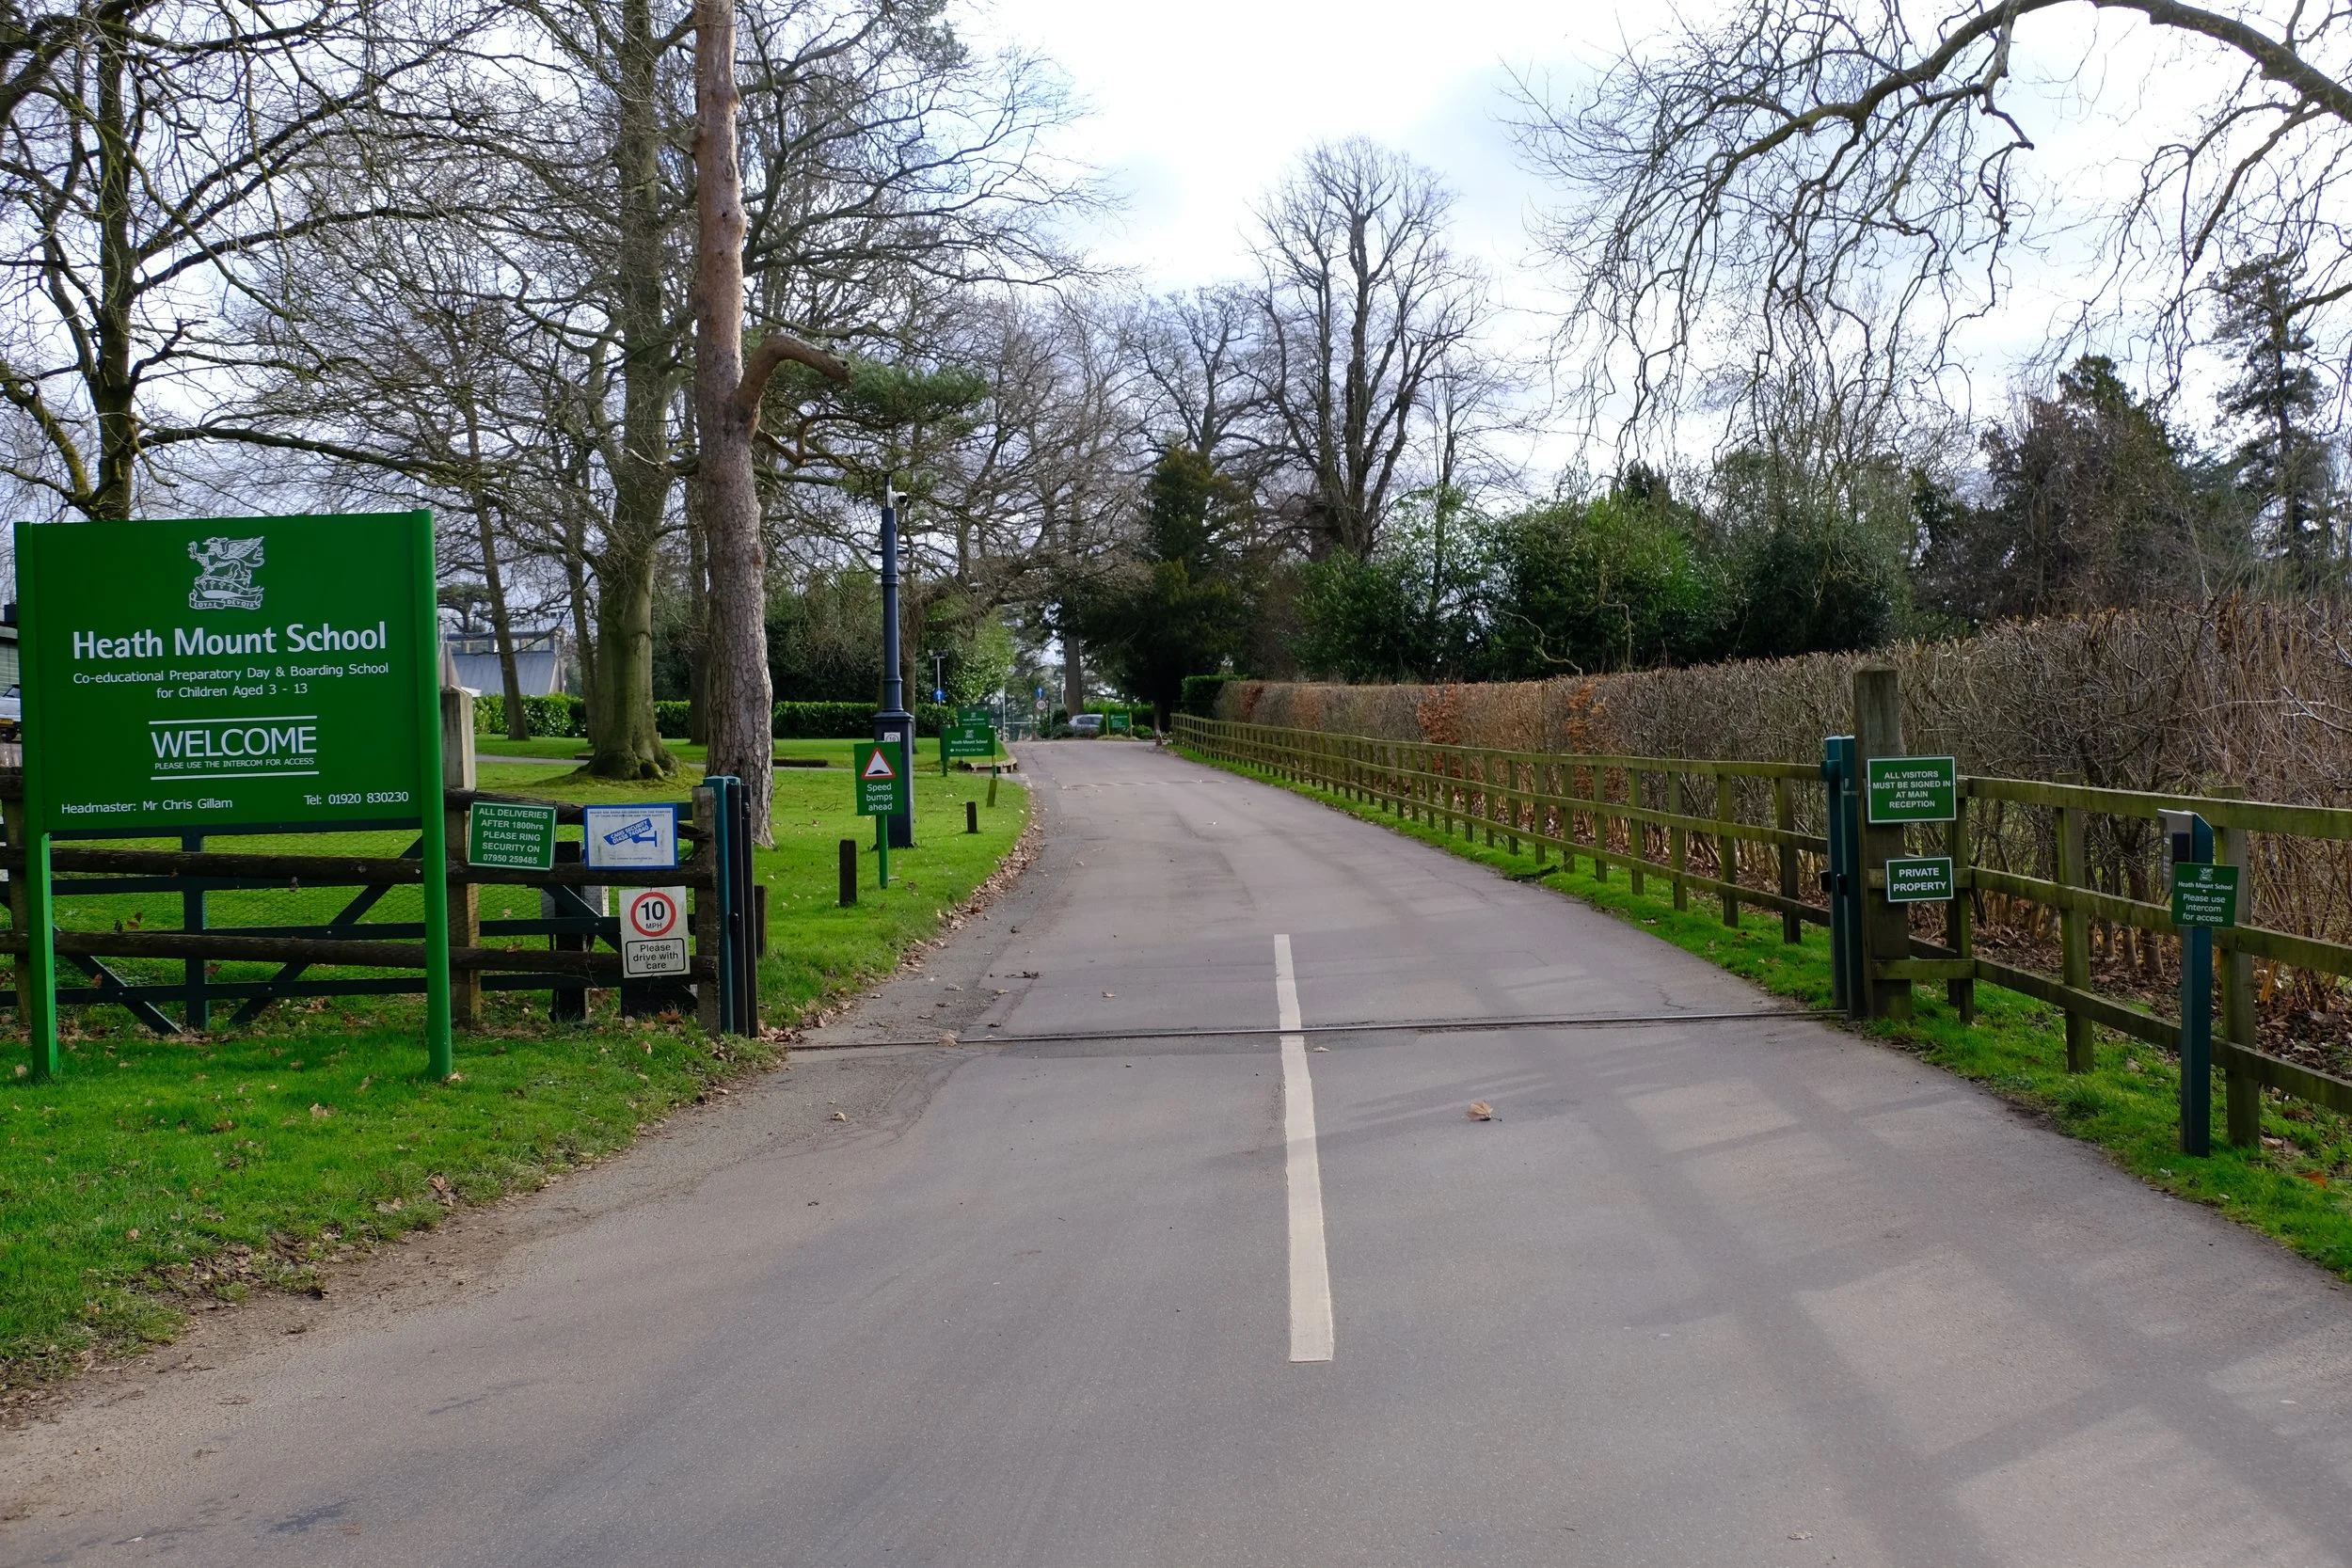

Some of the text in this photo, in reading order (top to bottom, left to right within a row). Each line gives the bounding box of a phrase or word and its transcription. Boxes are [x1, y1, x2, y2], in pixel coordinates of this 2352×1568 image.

[227, 599, 255, 608] DEVOIR
[73, 621, 386, 659] Heath Mount School
[73, 662, 389, 684] Co-educational Preparatory Day & Boarding School
[157, 688, 173, 698] for
[179, 686, 227, 698] Children
[232, 684, 263, 698] Aged
[269, 684, 277, 695] 3
[294, 683, 308, 694] 13
[151, 726, 317, 758] WELCOME
[223, 759, 262, 768] INTERCOM
[1901, 770, 1938, 779] VISITORS
[866, 783, 892, 792] Speed
[303, 791, 409, 805] Tel: 01920 830230
[866, 793, 893, 801] bumps
[61, 798, 232, 814] Headmaster: Mr Chris Gillam
[868, 802, 892, 811] ahead
[497, 809, 548, 819] DELIVERIES
[481, 819, 544, 831] AFTER 1800hrs
[625, 819, 648, 833] SECURITY
[483, 831, 541, 842] PLEASE RING
[482, 842, 540, 853] SECURITY ON
[483, 853, 538, 864] 07950 259485
[1899, 867, 1940, 878] PRIVATE
[1893, 880, 1947, 893] PROPERTY
[2183, 894, 2208, 902] Please
[641, 901, 665, 920] 10
[2196, 914, 2223, 923] access
[640, 943, 671, 952] Please
[660, 951, 678, 959] with
